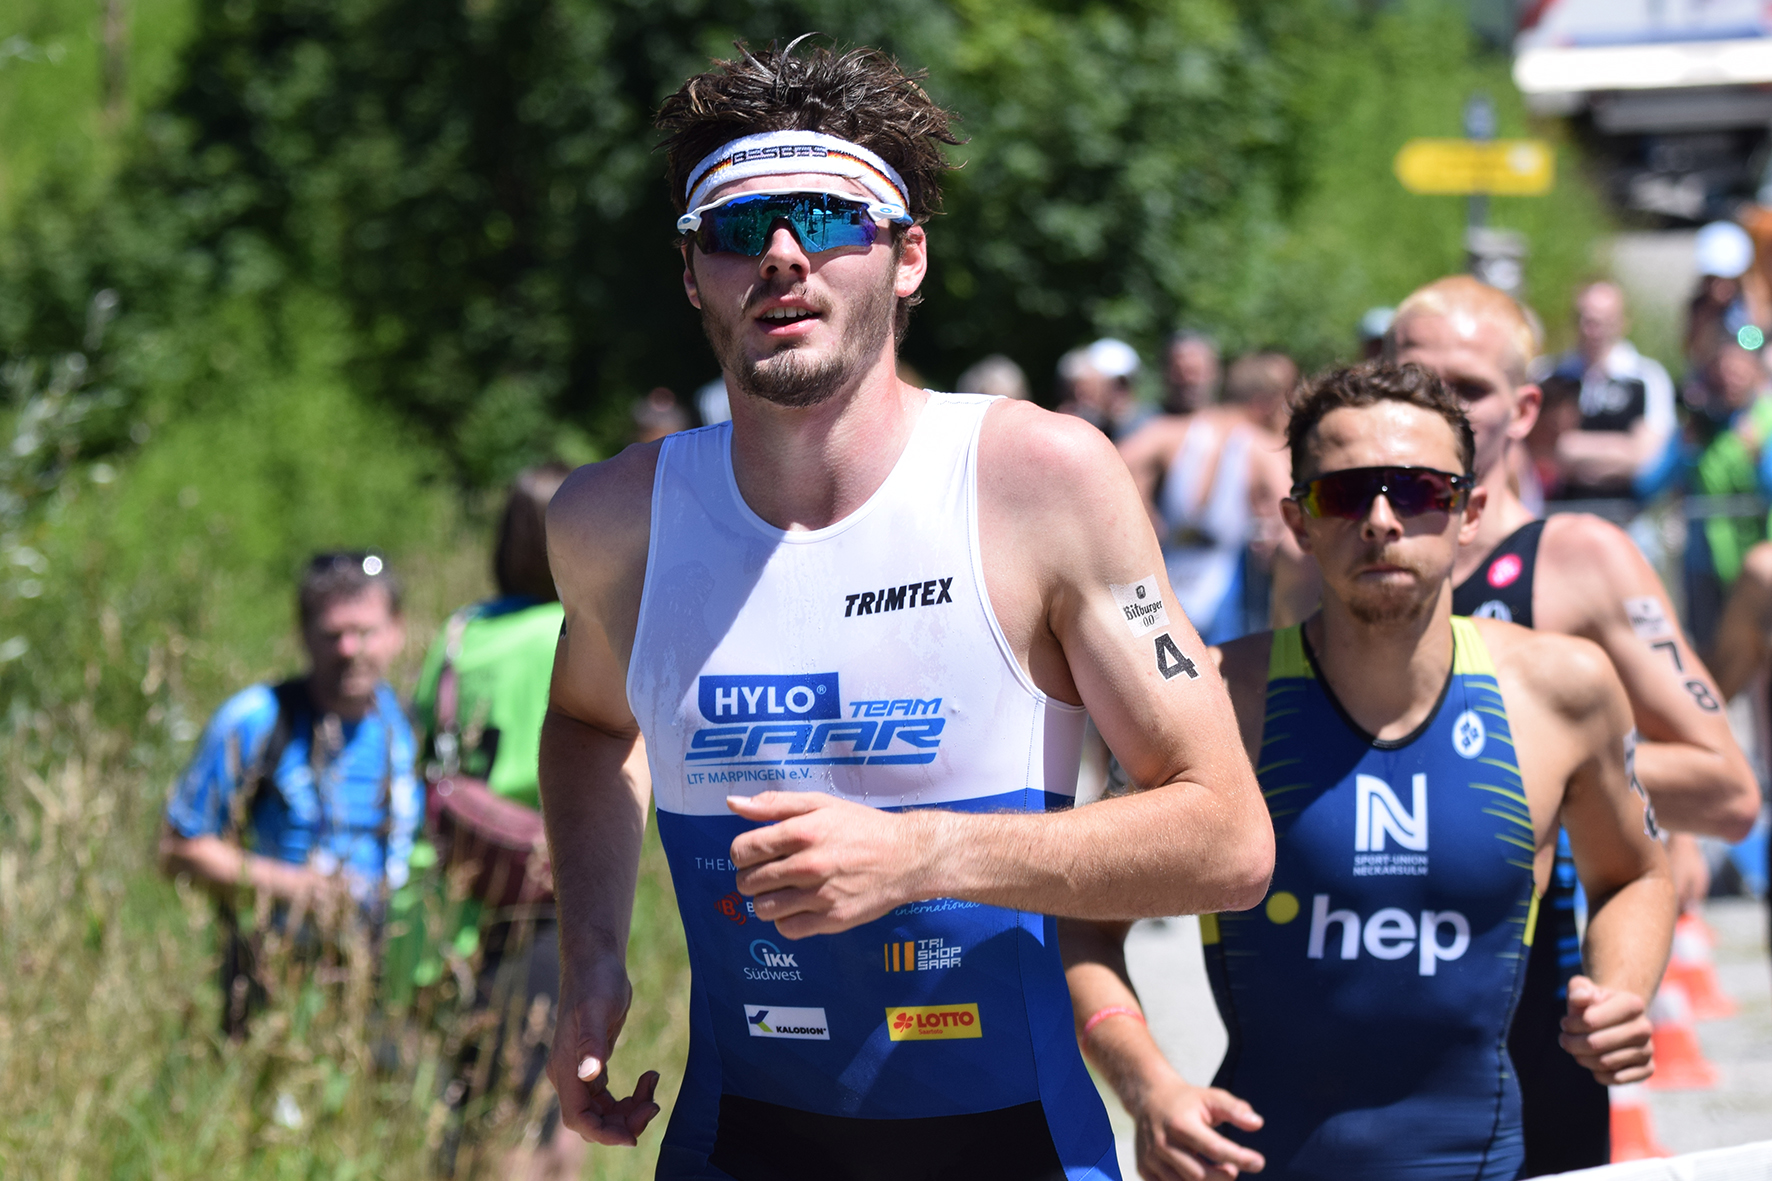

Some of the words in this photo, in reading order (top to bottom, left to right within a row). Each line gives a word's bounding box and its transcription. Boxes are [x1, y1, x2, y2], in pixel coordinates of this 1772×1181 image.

[732, 144, 828, 166] BESBES
[844, 577, 953, 618] TRIMTEX
[1122, 600, 1164, 621] Bitburger
[1154, 632, 1200, 681] 4
[848, 697, 943, 719] TEAM
[684, 717, 947, 762] SAAR
[687, 772, 705, 785] LTF
[708, 768, 786, 784] MARPINGEN
[789, 767, 813, 780] e.V.
[1352, 865, 1429, 877] NECKARSULM
[917, 938, 944, 950] TRI
[1306, 893, 1472, 977] hep
[917, 946, 962, 961] SHOP
[917, 957, 962, 971] SAAR
[743, 967, 803, 981] Südwest
[916, 1011, 975, 1028] LOTTO
